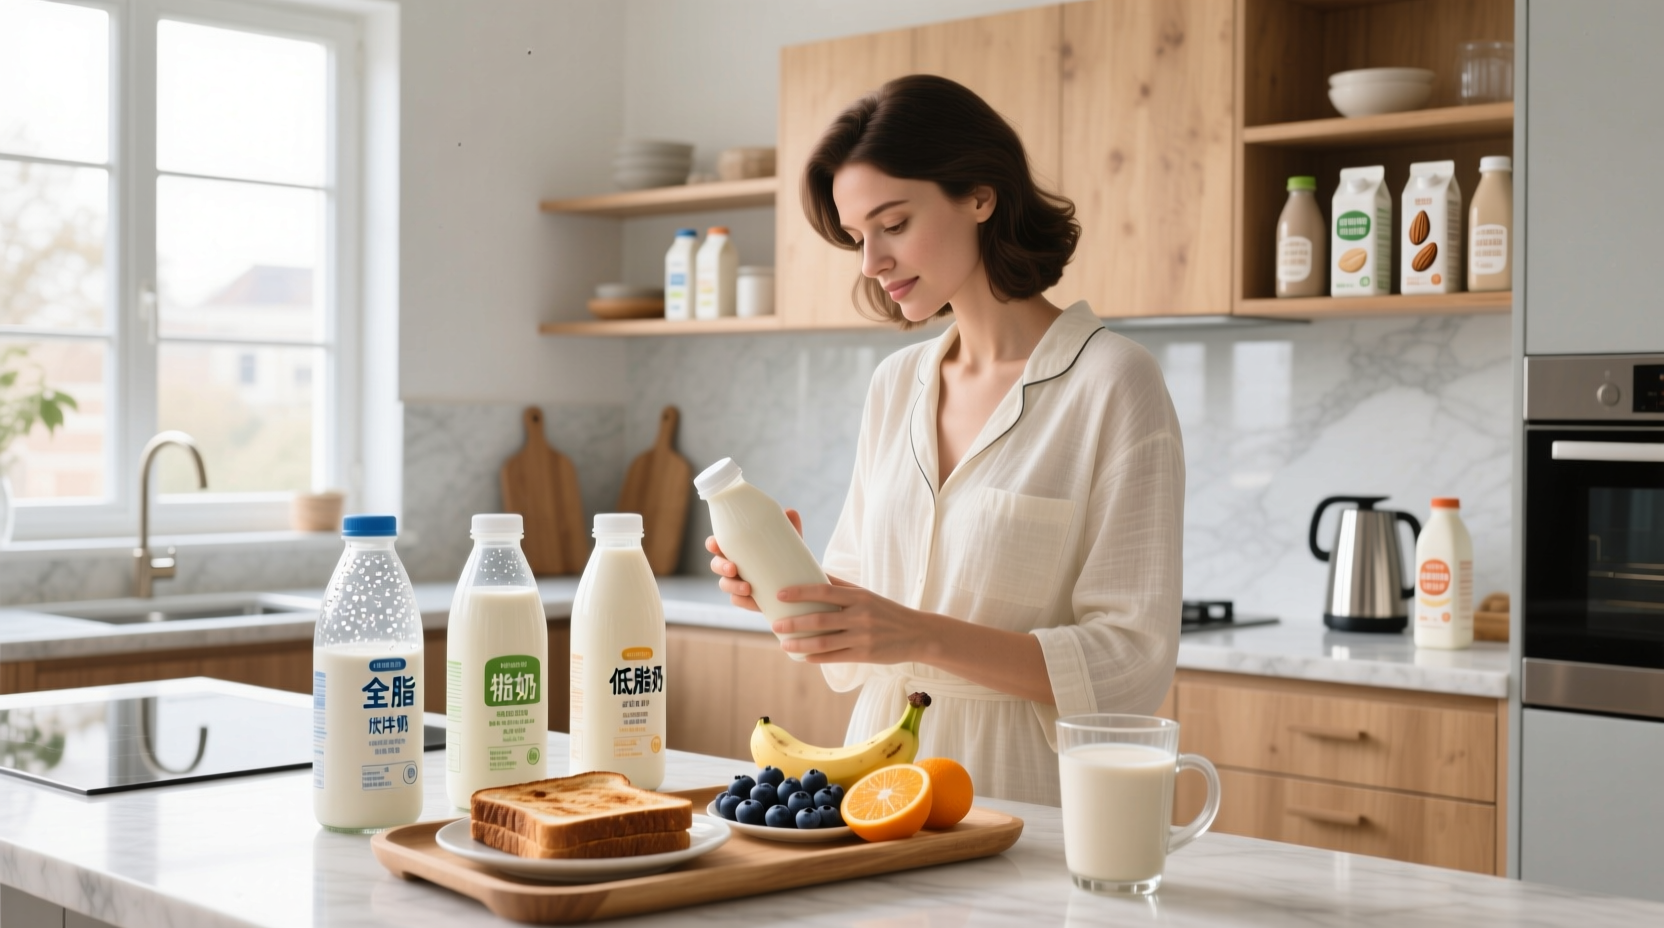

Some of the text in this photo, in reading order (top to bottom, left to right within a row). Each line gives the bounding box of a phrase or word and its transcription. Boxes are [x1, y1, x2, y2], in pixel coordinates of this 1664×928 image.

[362, 676, 416, 709] 全脂
[609, 665, 663, 695] 低脂奶
